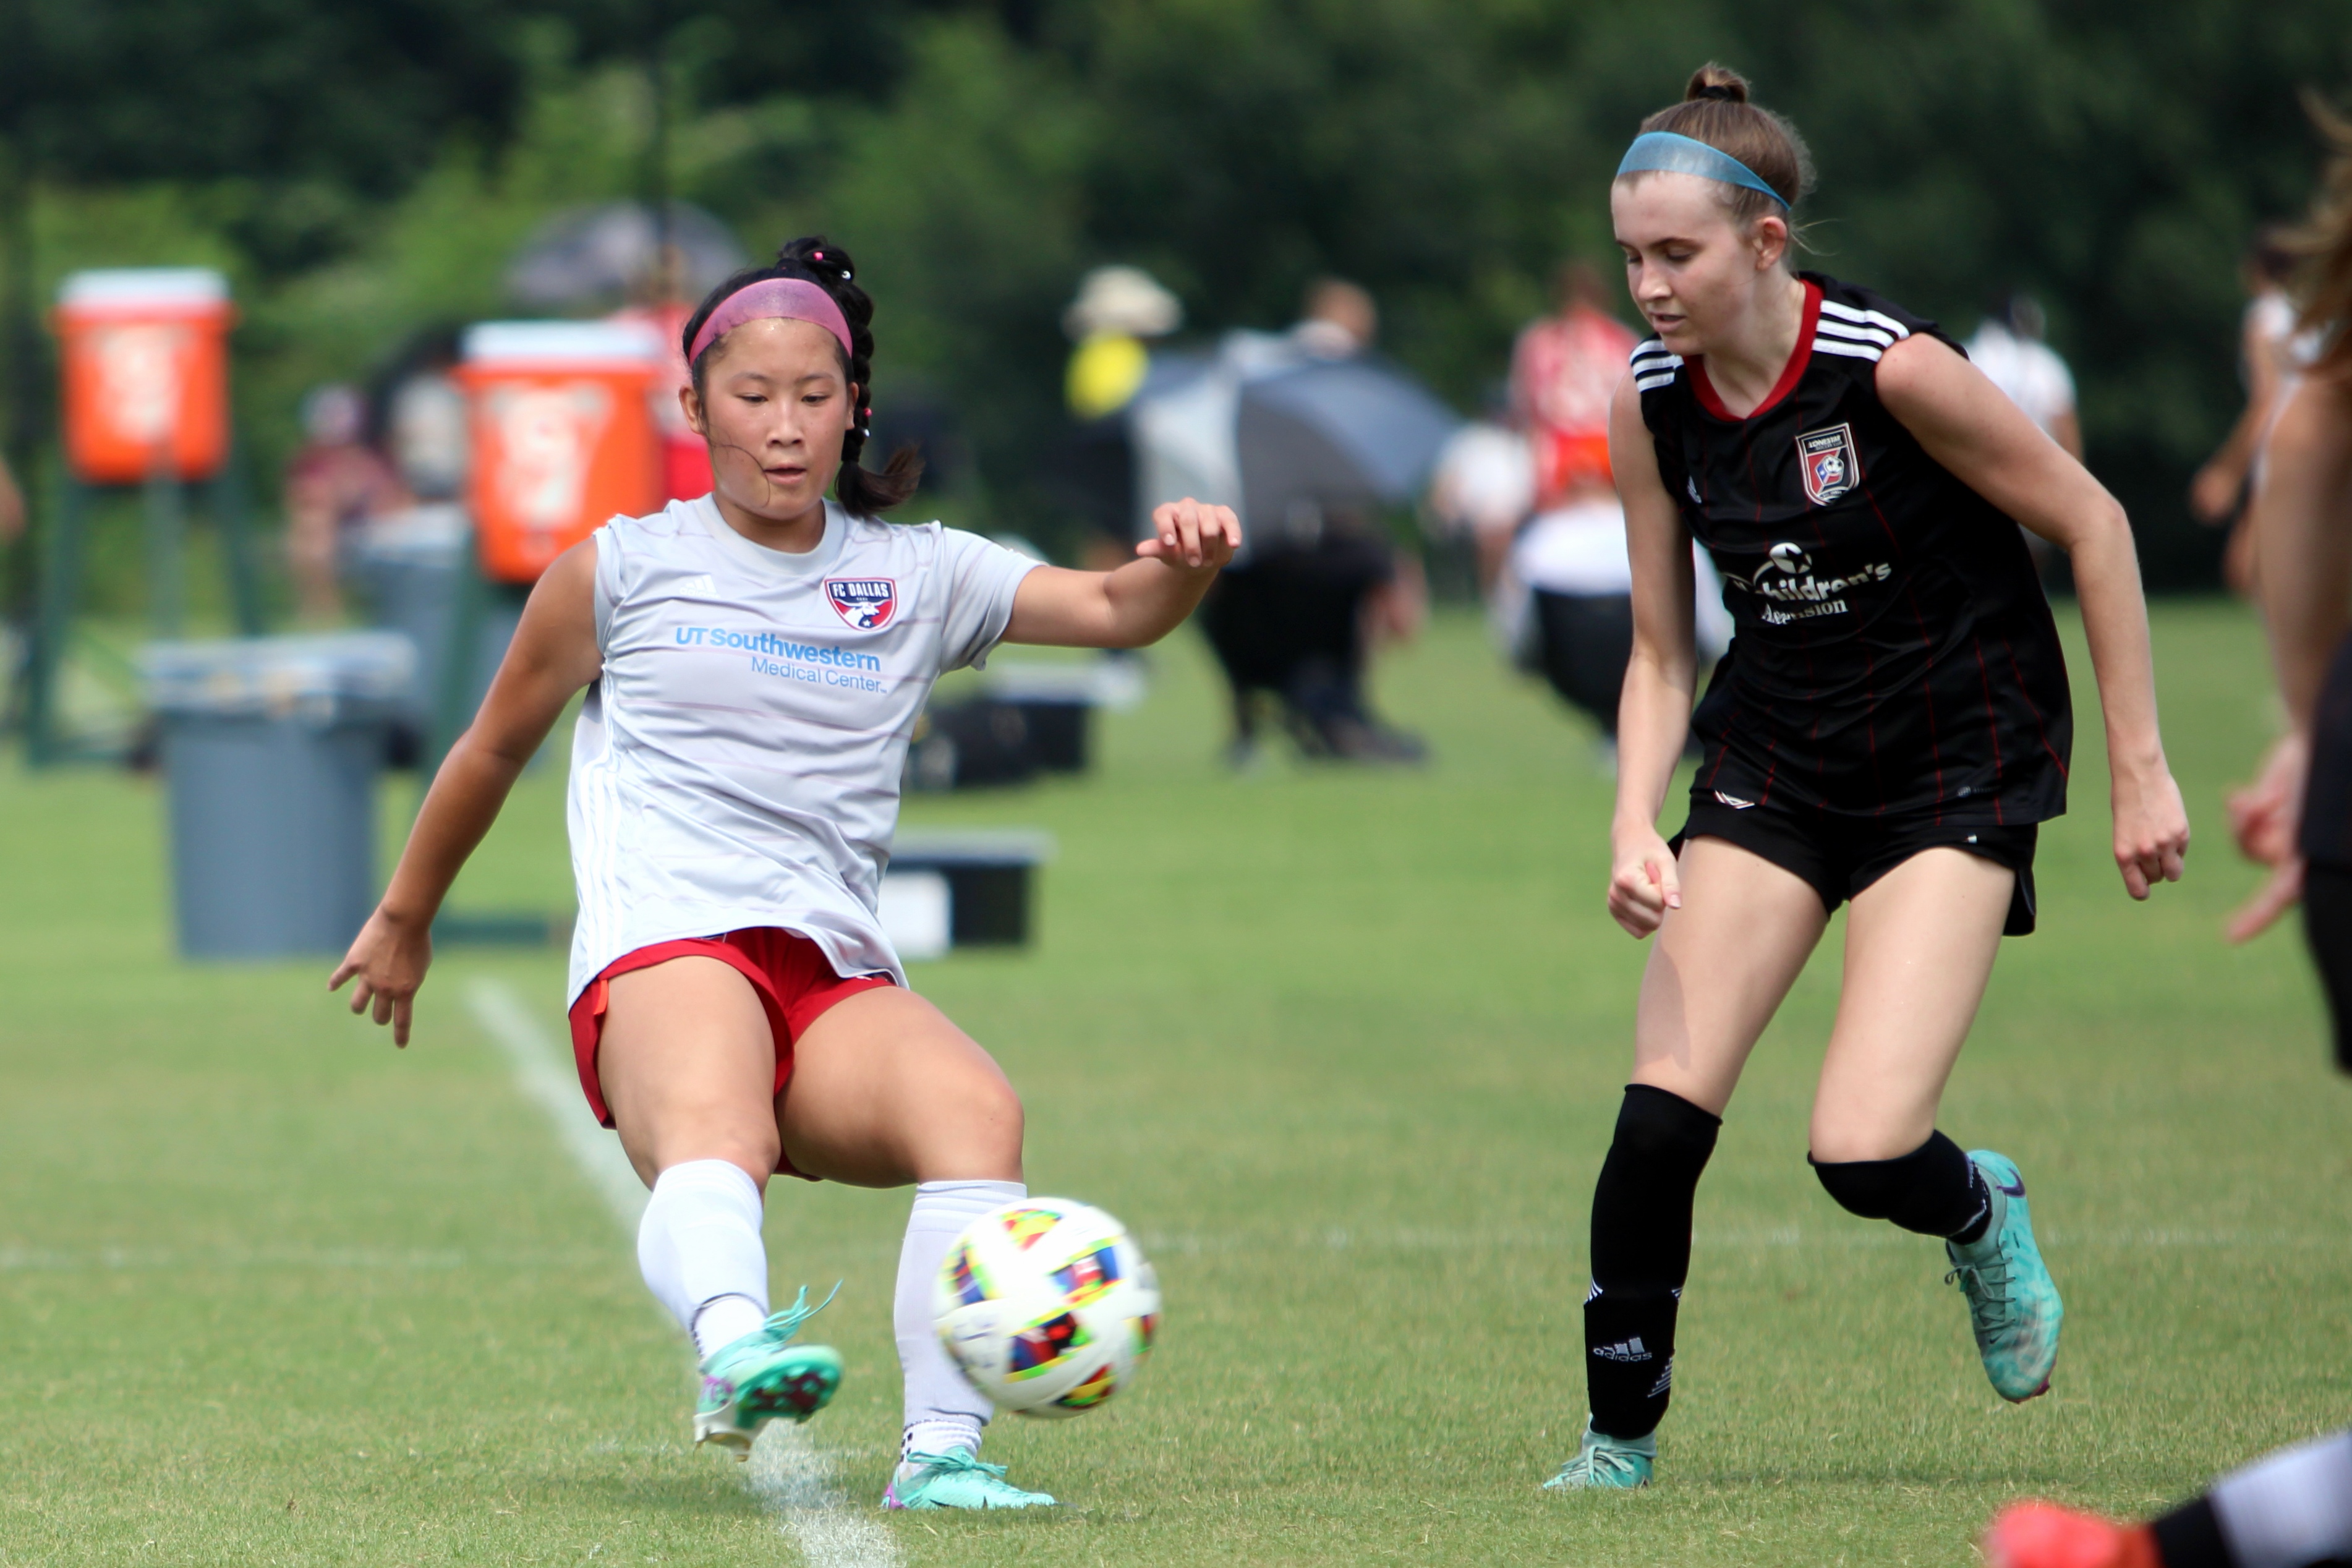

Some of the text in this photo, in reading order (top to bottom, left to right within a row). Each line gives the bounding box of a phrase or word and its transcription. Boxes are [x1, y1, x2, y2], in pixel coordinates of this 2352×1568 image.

[832, 582, 889, 598] FC DALLAS
[676, 627, 881, 672] UT Southwestern
[751, 656, 822, 683] Medical
[1593, 1347, 1652, 1361] adidas
